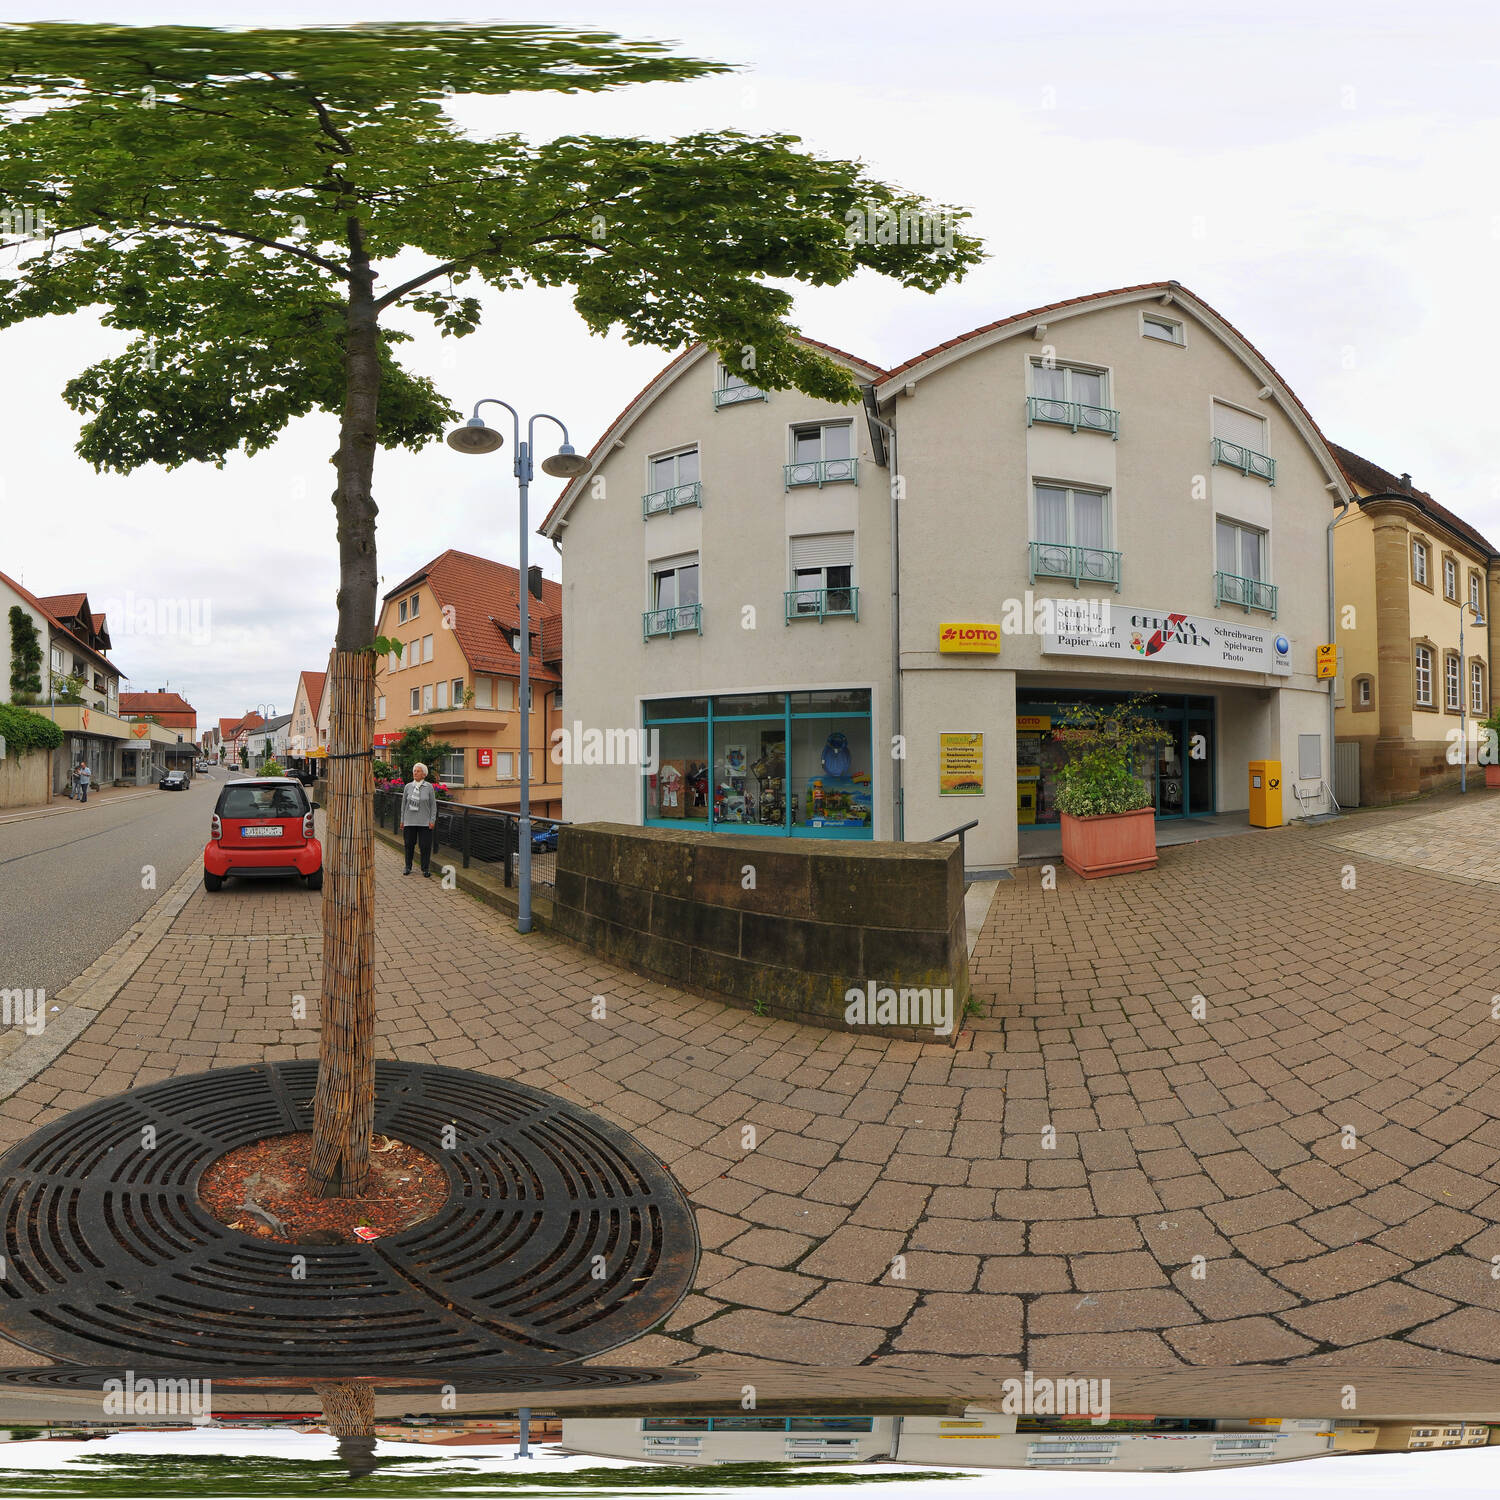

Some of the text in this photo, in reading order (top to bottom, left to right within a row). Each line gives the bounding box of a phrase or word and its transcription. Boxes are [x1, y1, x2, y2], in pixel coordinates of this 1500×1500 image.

[1057, 608, 1090, 619] Schul-
[959, 629, 998, 640] LOTTO
[1057, 621, 1116, 635] Bürobedarf
[1214, 626, 1263, 642] Schreibwaren
[1057, 635, 1121, 648] Papierwaren
[1224, 640, 1263, 653] Spielwaren
[1222, 651, 1244, 661] Photo
